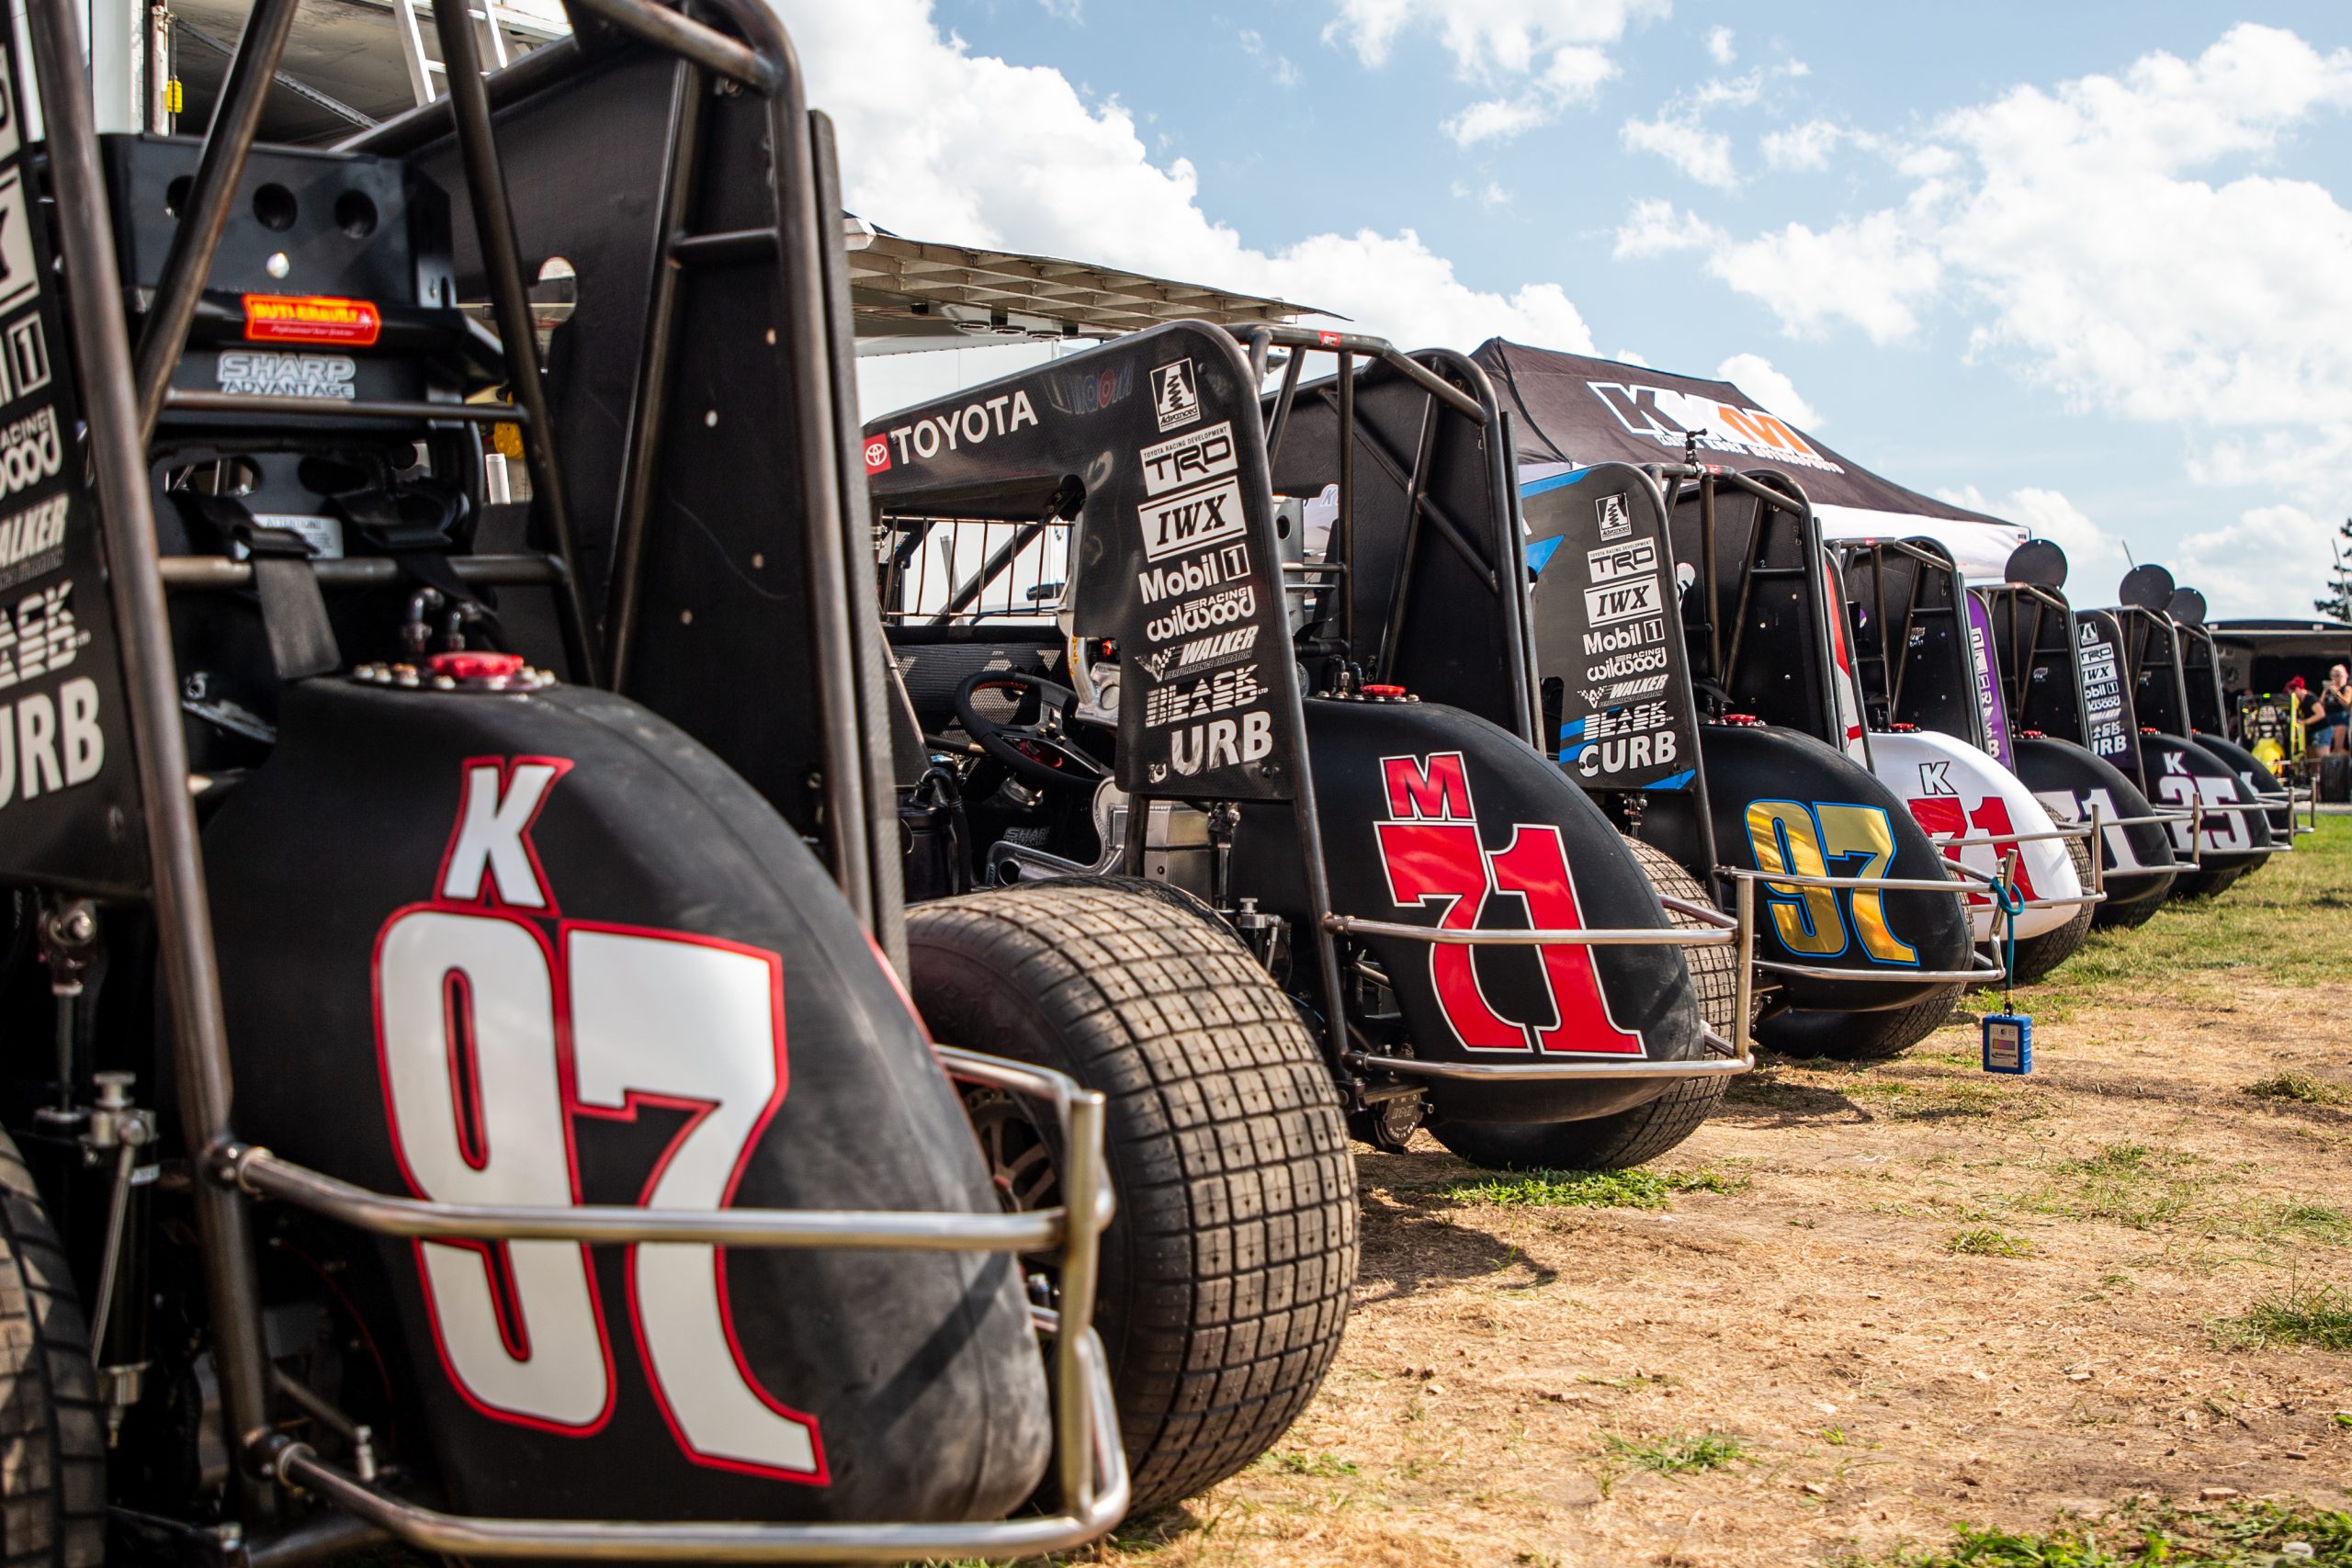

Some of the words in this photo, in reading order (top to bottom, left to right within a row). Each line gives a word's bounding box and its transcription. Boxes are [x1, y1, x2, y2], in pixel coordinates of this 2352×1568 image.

[220, 351, 355, 382] SHARP
[224, 380, 355, 399] ADVANTAGE
[0, 412, 49, 450] ACING
[890, 390, 1038, 465] TOYOTA
[1160, 405, 1198, 425] Advanced
[1143, 448, 1164, 458] TOYOTA
[1165, 440, 1186, 453] RACING
[1187, 426, 1228, 445] DEVELOPMENT
[1145, 434, 1232, 482] TRD
[0, 493, 69, 562] ALKER
[1157, 493, 1227, 546] IWX
[1602, 525, 1630, 536] Advanced
[1590, 546, 1654, 575] TRD
[1138, 553, 1219, 604] Mobil
[0, 580, 74, 649] ACK
[1147, 585, 1256, 641] wilwood
[1199, 588, 1248, 608] RACING
[1597, 585, 1649, 617] IWX
[1180, 626, 1260, 666] WALKER
[1583, 623, 1642, 656] Mobil
[1625, 649, 1662, 660] RACING
[1587, 647, 1667, 682] wilwood
[1610, 673, 1668, 699] WALKER
[2086, 685, 2106, 699] obil
[2087, 694, 2120, 712] lwood
[1584, 715, 1667, 740] BEARD
[1585, 701, 1667, 727] BLACK
[1578, 730, 1677, 778] CURB
[2163, 750, 2189, 775] K
[1379, 750, 1477, 821] M
[1918, 761, 1959, 795] K
[433, 756, 574, 917] K
[1004, 828, 1050, 839] SHAR
[1907, 796, 2051, 906] 71
[1744, 798, 1920, 966] 97
[1373, 820, 1647, 1058] 71
[371, 899, 831, 1486] 97
